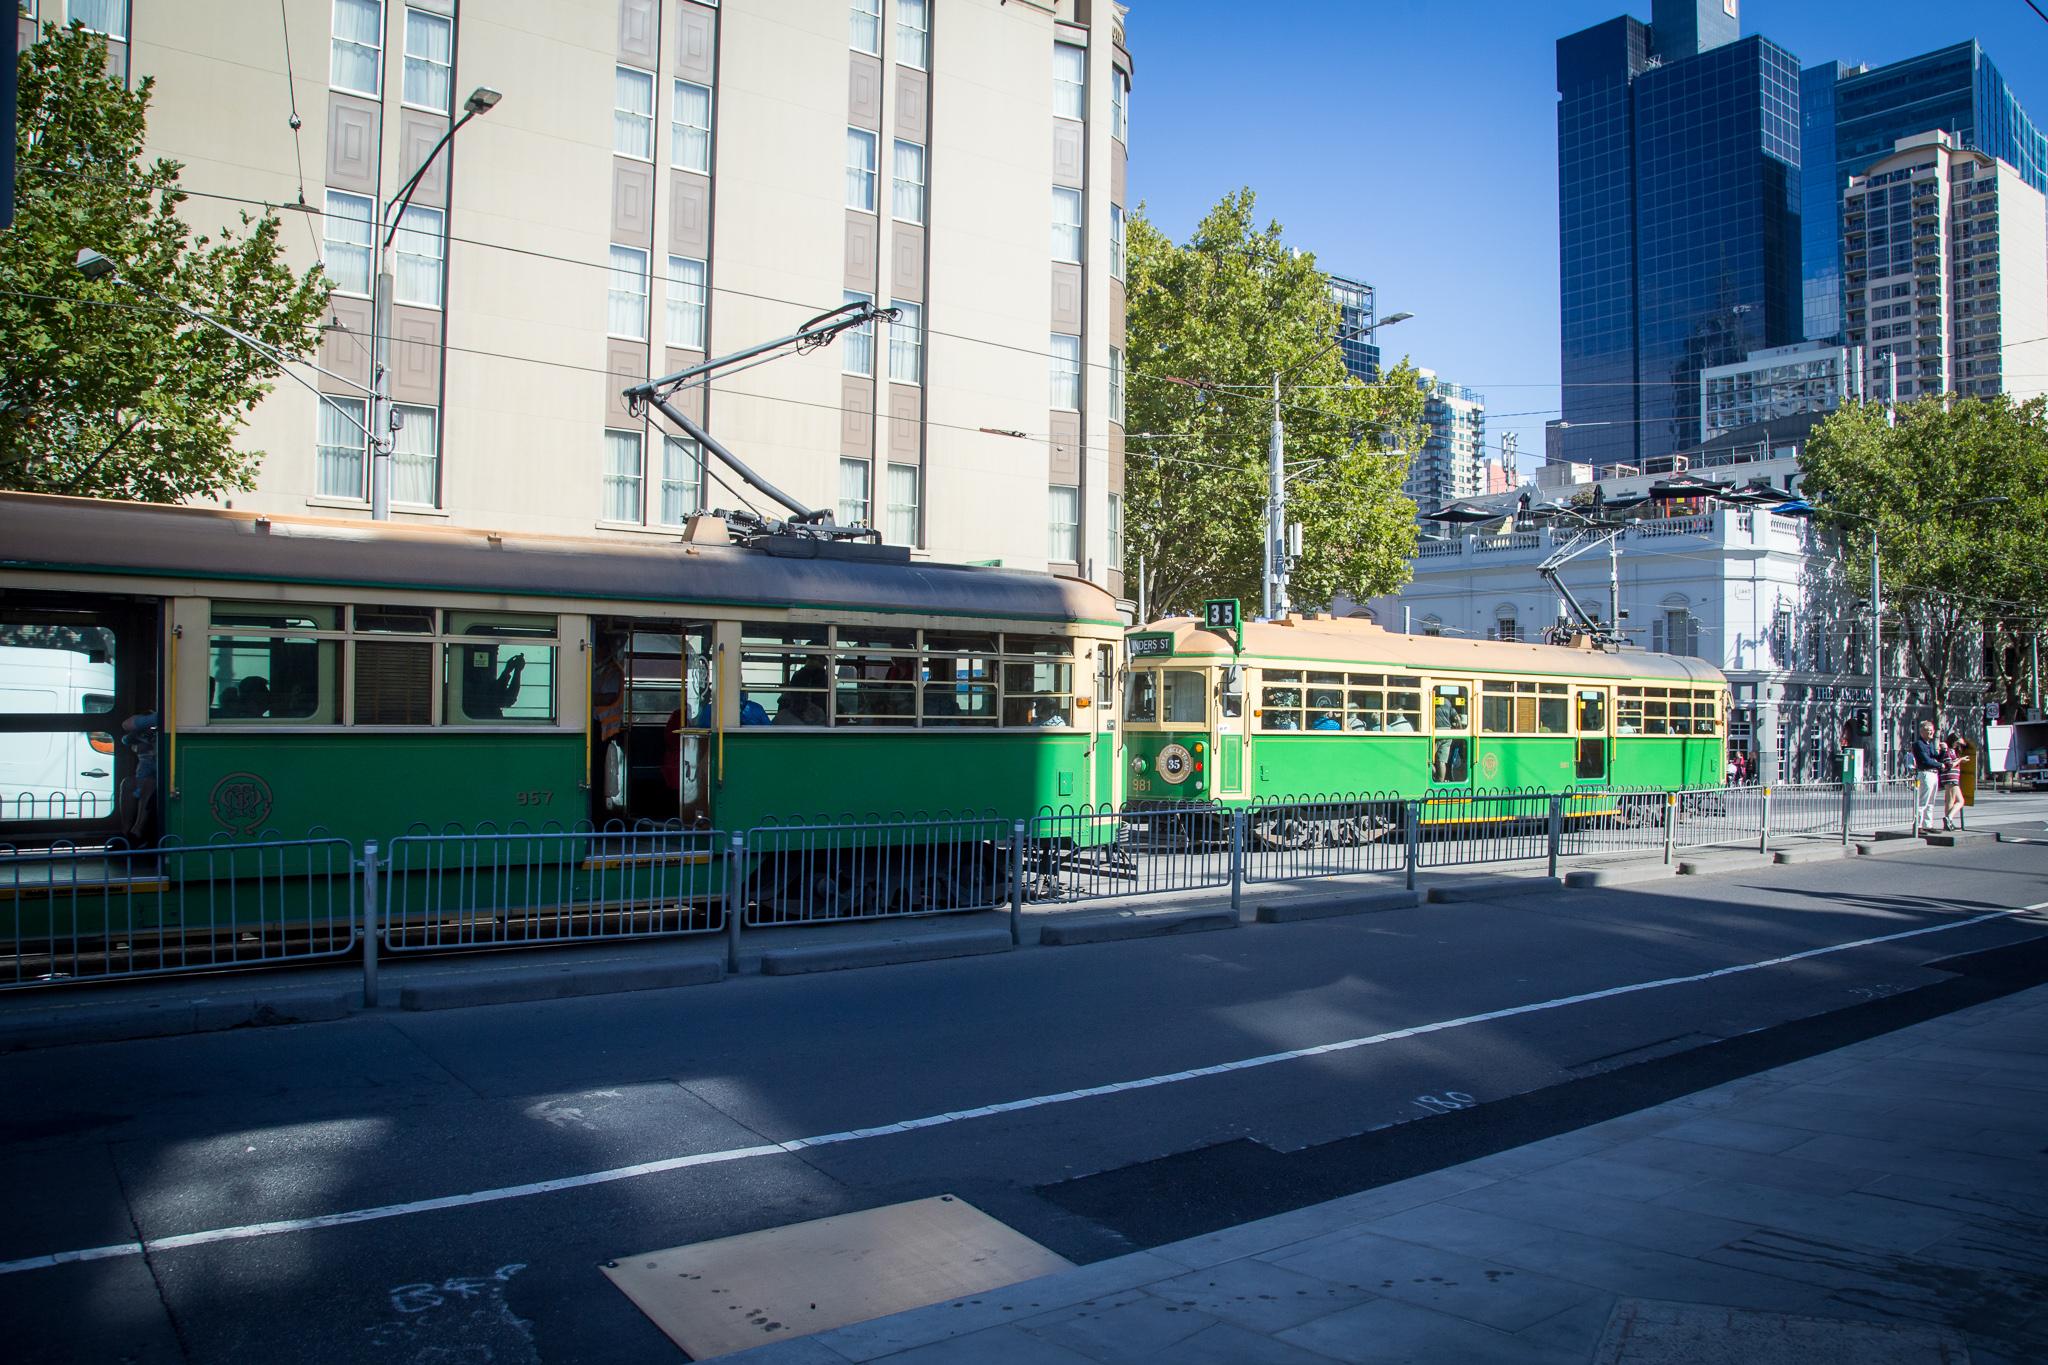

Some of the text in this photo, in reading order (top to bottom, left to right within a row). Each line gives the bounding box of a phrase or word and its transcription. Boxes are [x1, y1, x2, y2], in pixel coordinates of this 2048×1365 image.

[1211, 604, 1233, 623] 35
[1132, 638, 1169, 650] INDERS ST
[1816, 686, 1872, 701] THE IMPERIA
[1168, 760, 1180, 769] 35
[1132, 778, 1151, 791] 981
[516, 791, 553, 804] 957
